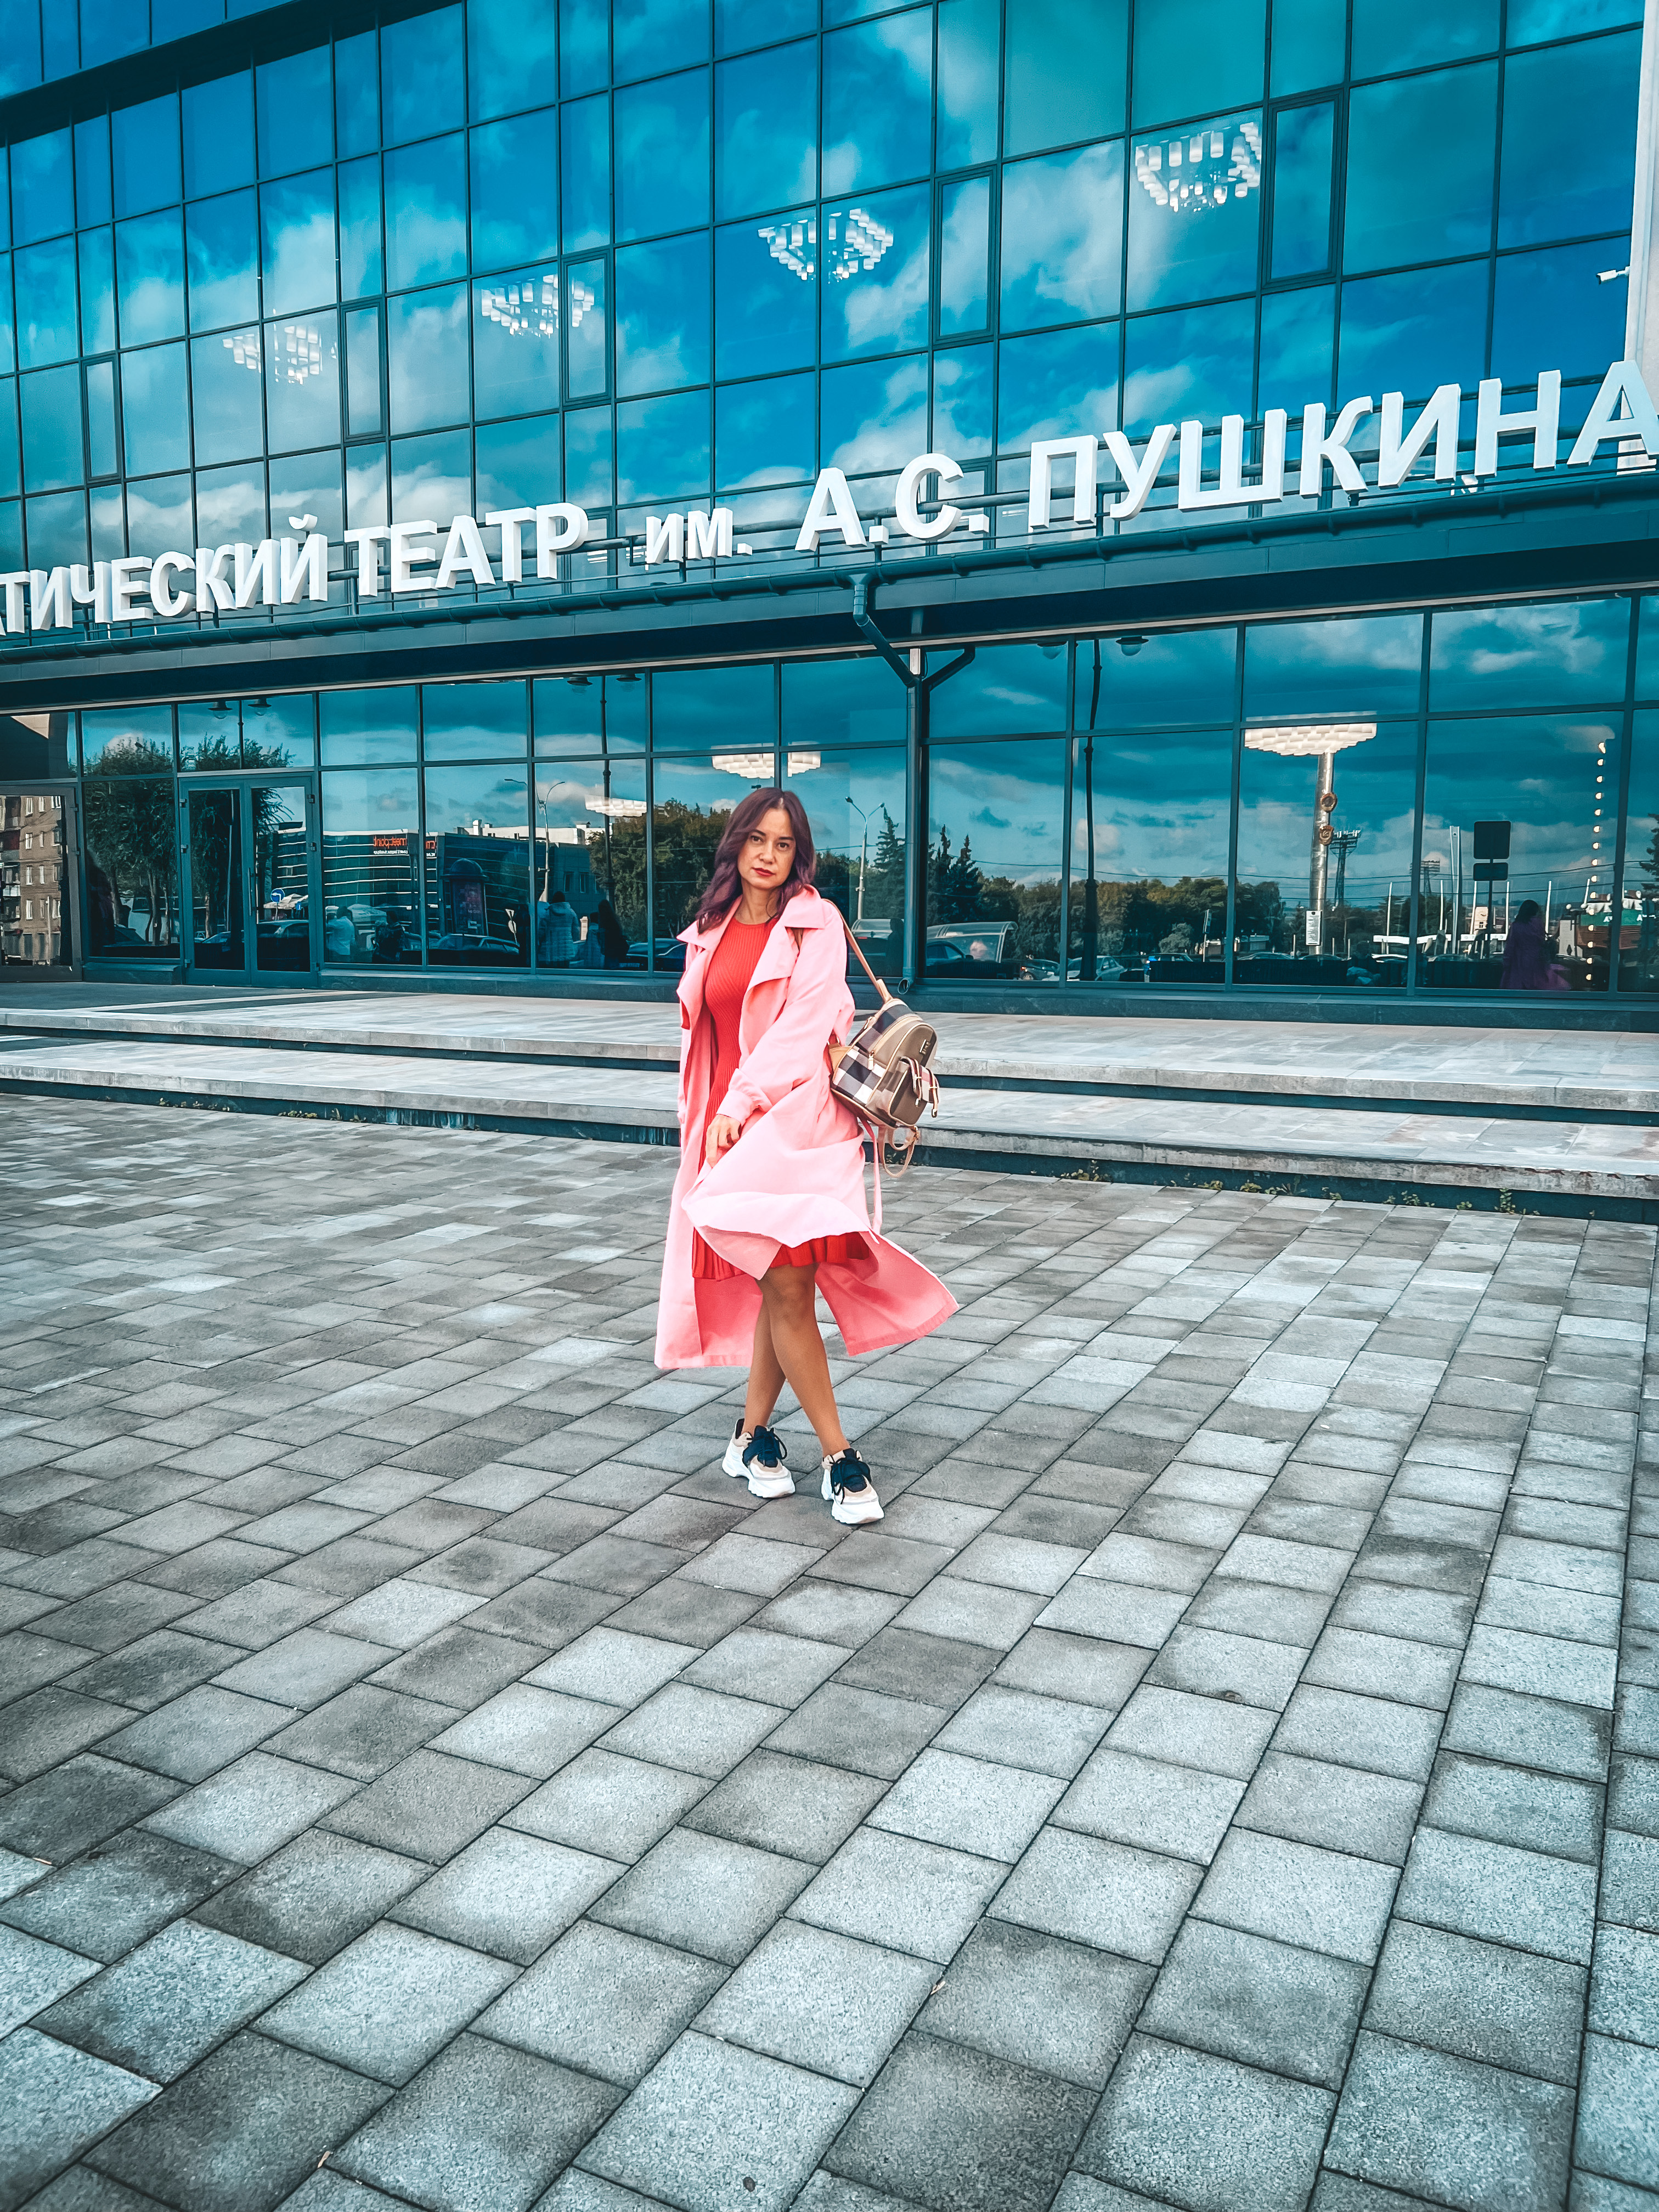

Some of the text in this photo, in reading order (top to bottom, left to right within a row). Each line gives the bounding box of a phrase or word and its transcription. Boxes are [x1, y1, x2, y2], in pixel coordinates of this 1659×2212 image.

[0, 514, 329, 636] ТИЧЕСКИЙ
[344, 503, 589, 597] ТЕАТР
[1029, 359, 1659, 529] ПУШКИНА
